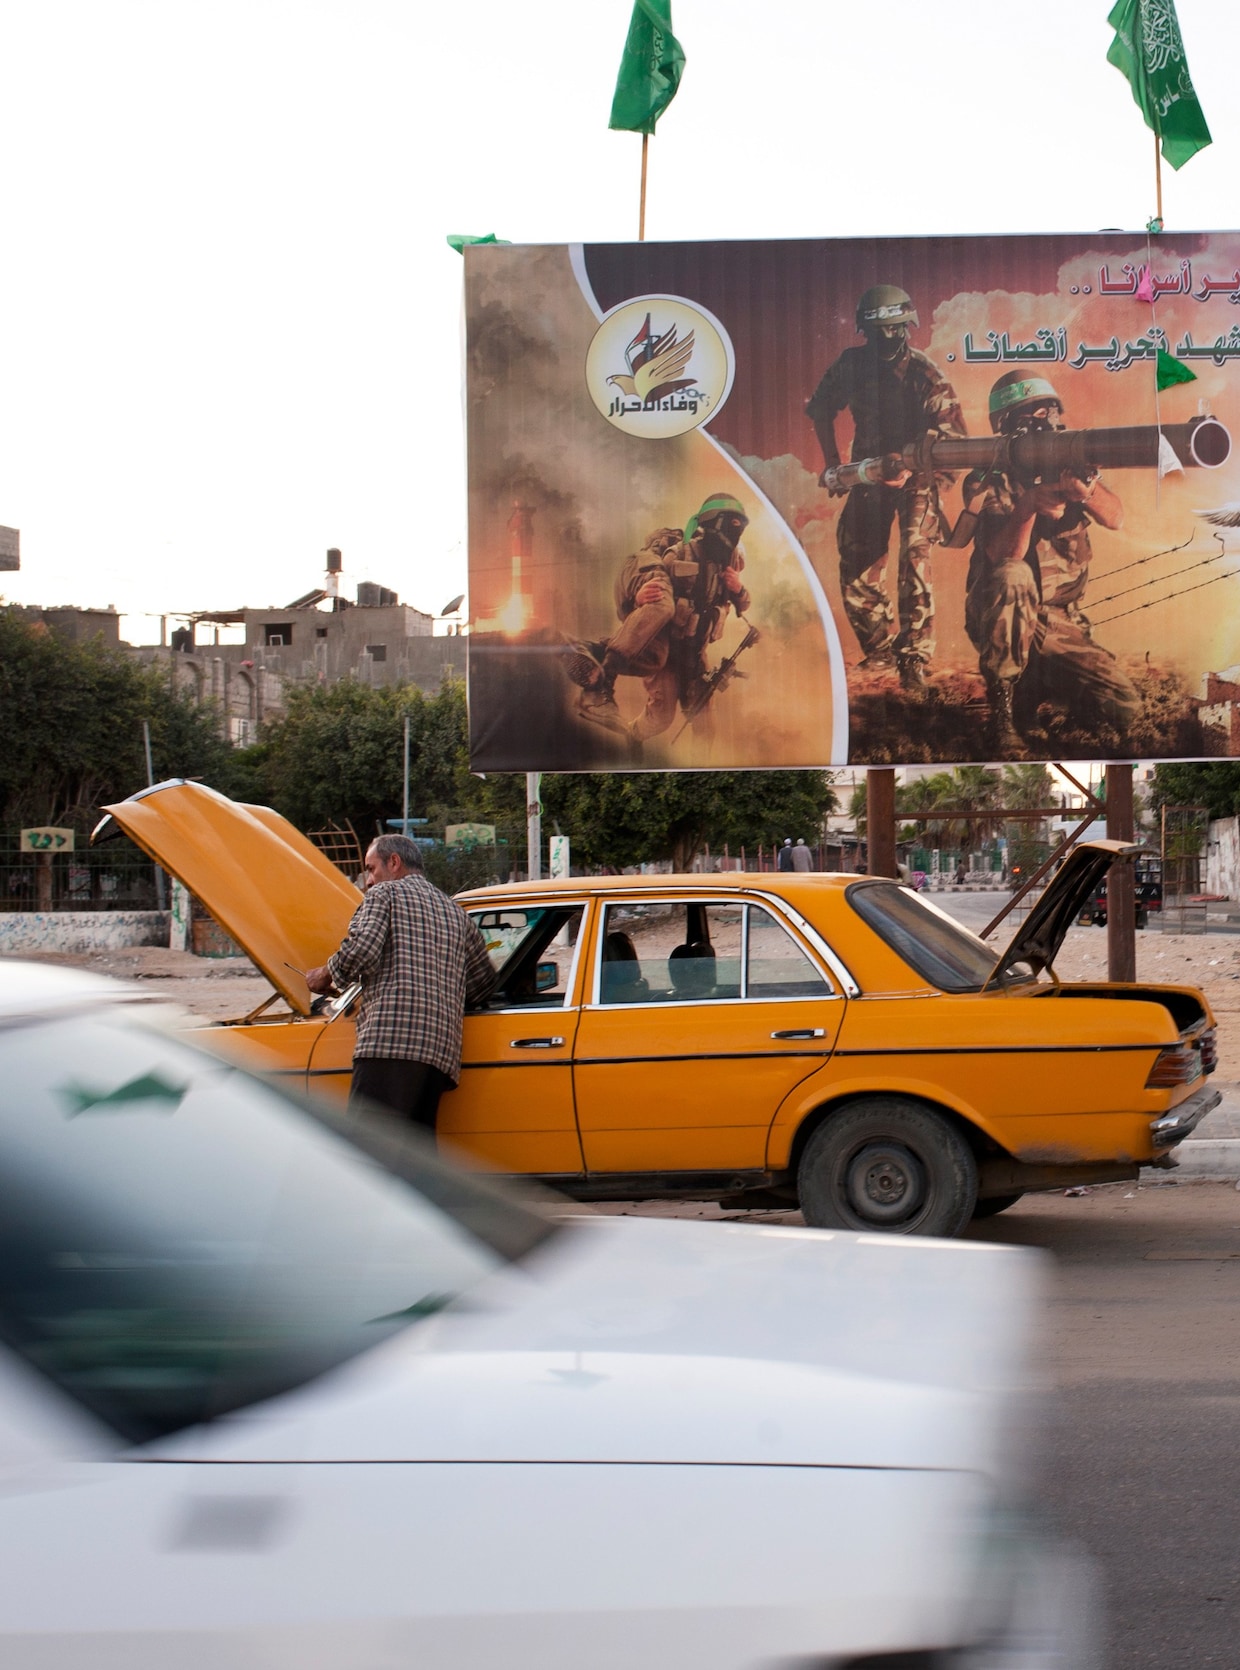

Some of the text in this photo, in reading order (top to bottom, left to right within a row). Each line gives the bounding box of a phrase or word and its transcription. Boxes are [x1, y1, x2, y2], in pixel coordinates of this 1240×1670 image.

[963, 327, 1068, 362] أقصانا
[1068, 327, 1169, 371] تحرير
[662, 395, 698, 415] وفاء
